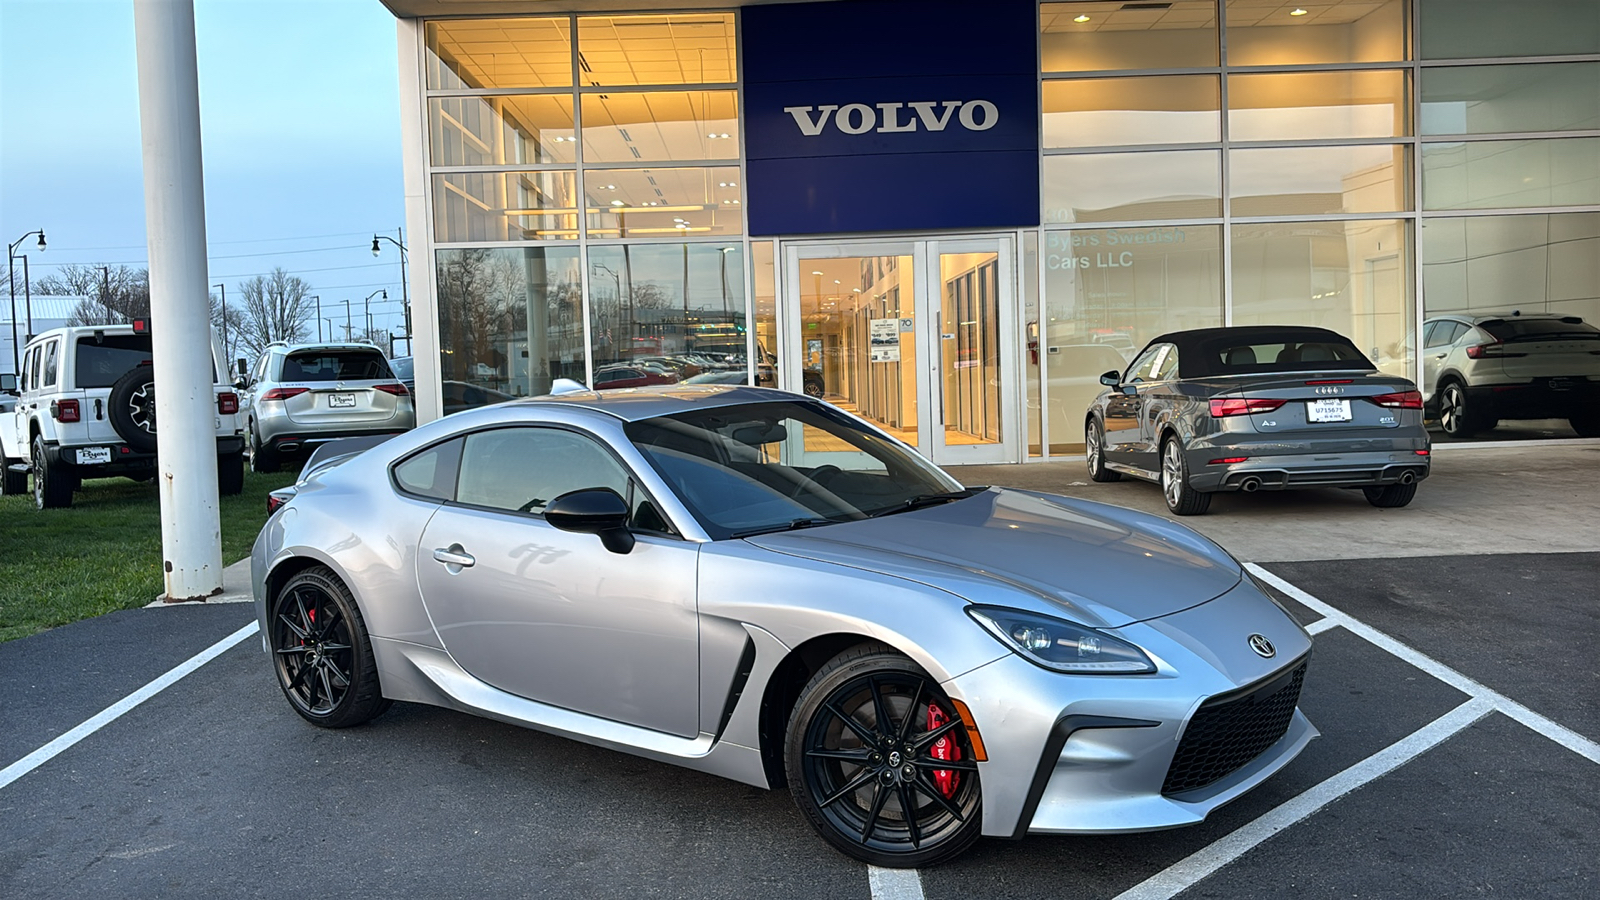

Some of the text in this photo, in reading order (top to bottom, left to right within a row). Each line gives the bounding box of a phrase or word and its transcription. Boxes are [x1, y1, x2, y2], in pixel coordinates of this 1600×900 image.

[784, 99, 999, 136] VOLVO
[1047, 228, 1186, 251] Byers Swedish
[1047, 251, 1133, 270] Cars LLC
